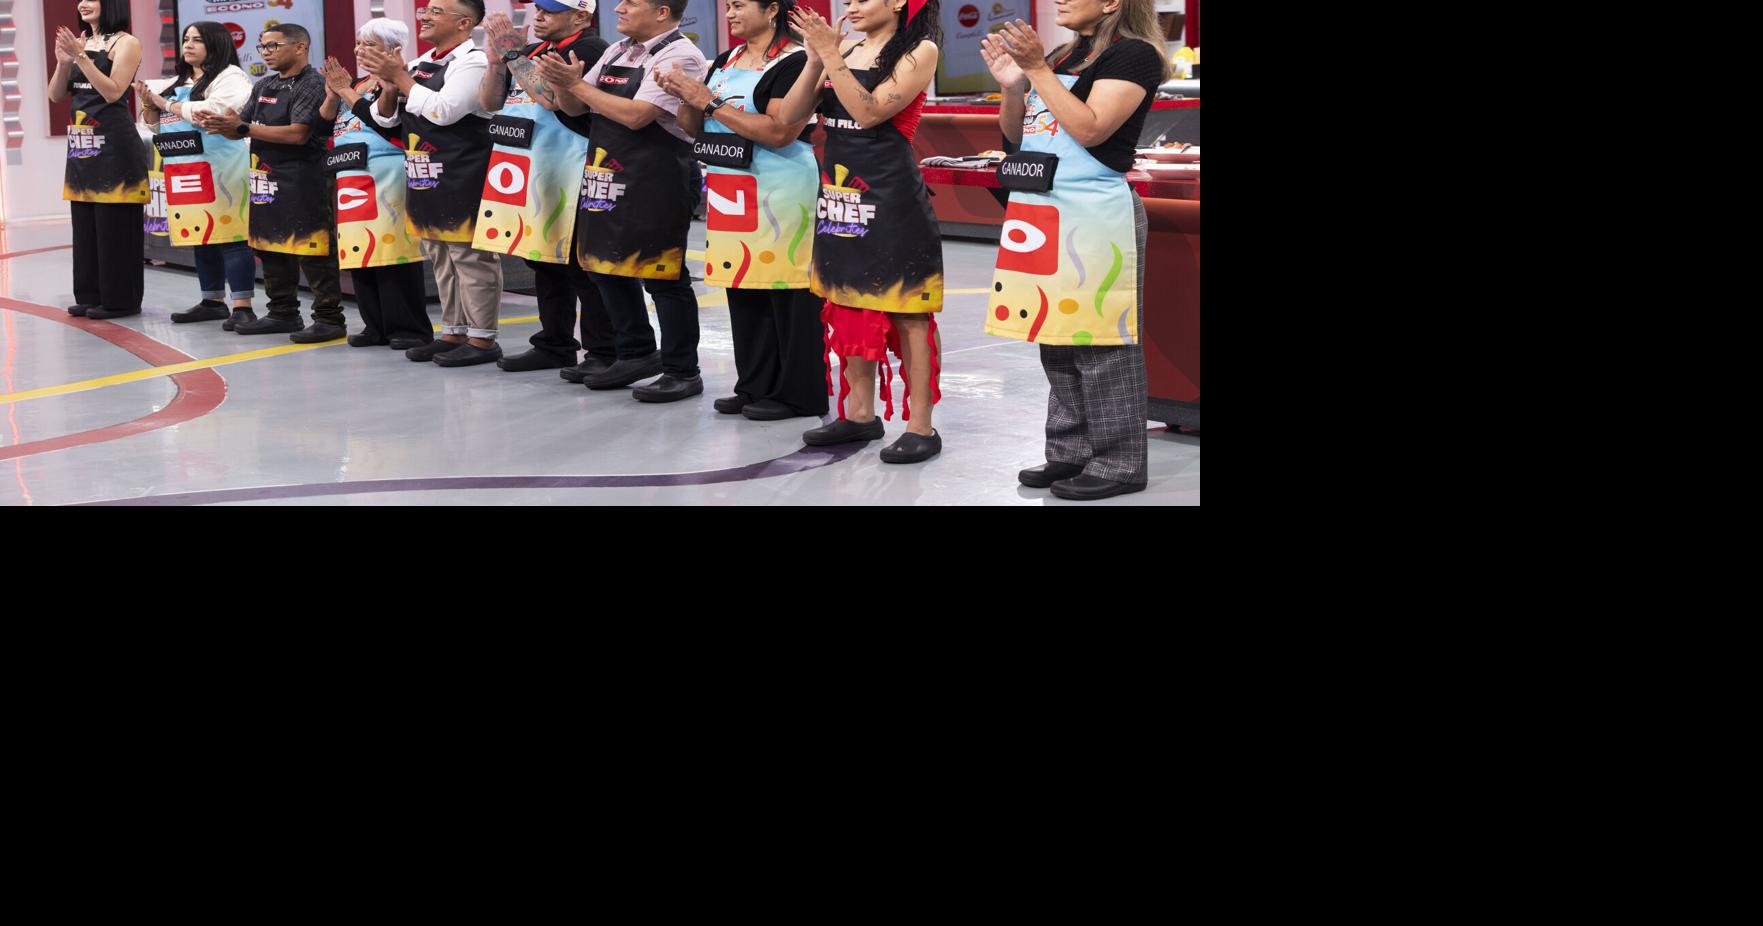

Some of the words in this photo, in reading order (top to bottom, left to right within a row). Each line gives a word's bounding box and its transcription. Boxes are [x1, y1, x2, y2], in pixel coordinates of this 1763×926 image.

[206, 2, 264, 13] ECONO
[488, 123, 525, 139] GANADOR
[1039, 115, 1060, 136] 54
[326, 150, 361, 166] GANADOR
[693, 142, 744, 158] GANADOR
[1002, 161, 1044, 177] GANADOR
[171, 174, 202, 193] E
[488, 161, 525, 195] O
[580, 177, 627, 202] CHEF
[822, 188, 861, 204] SUPER
[817, 197, 876, 226] CHEF
[1000, 219, 1047, 253] O
